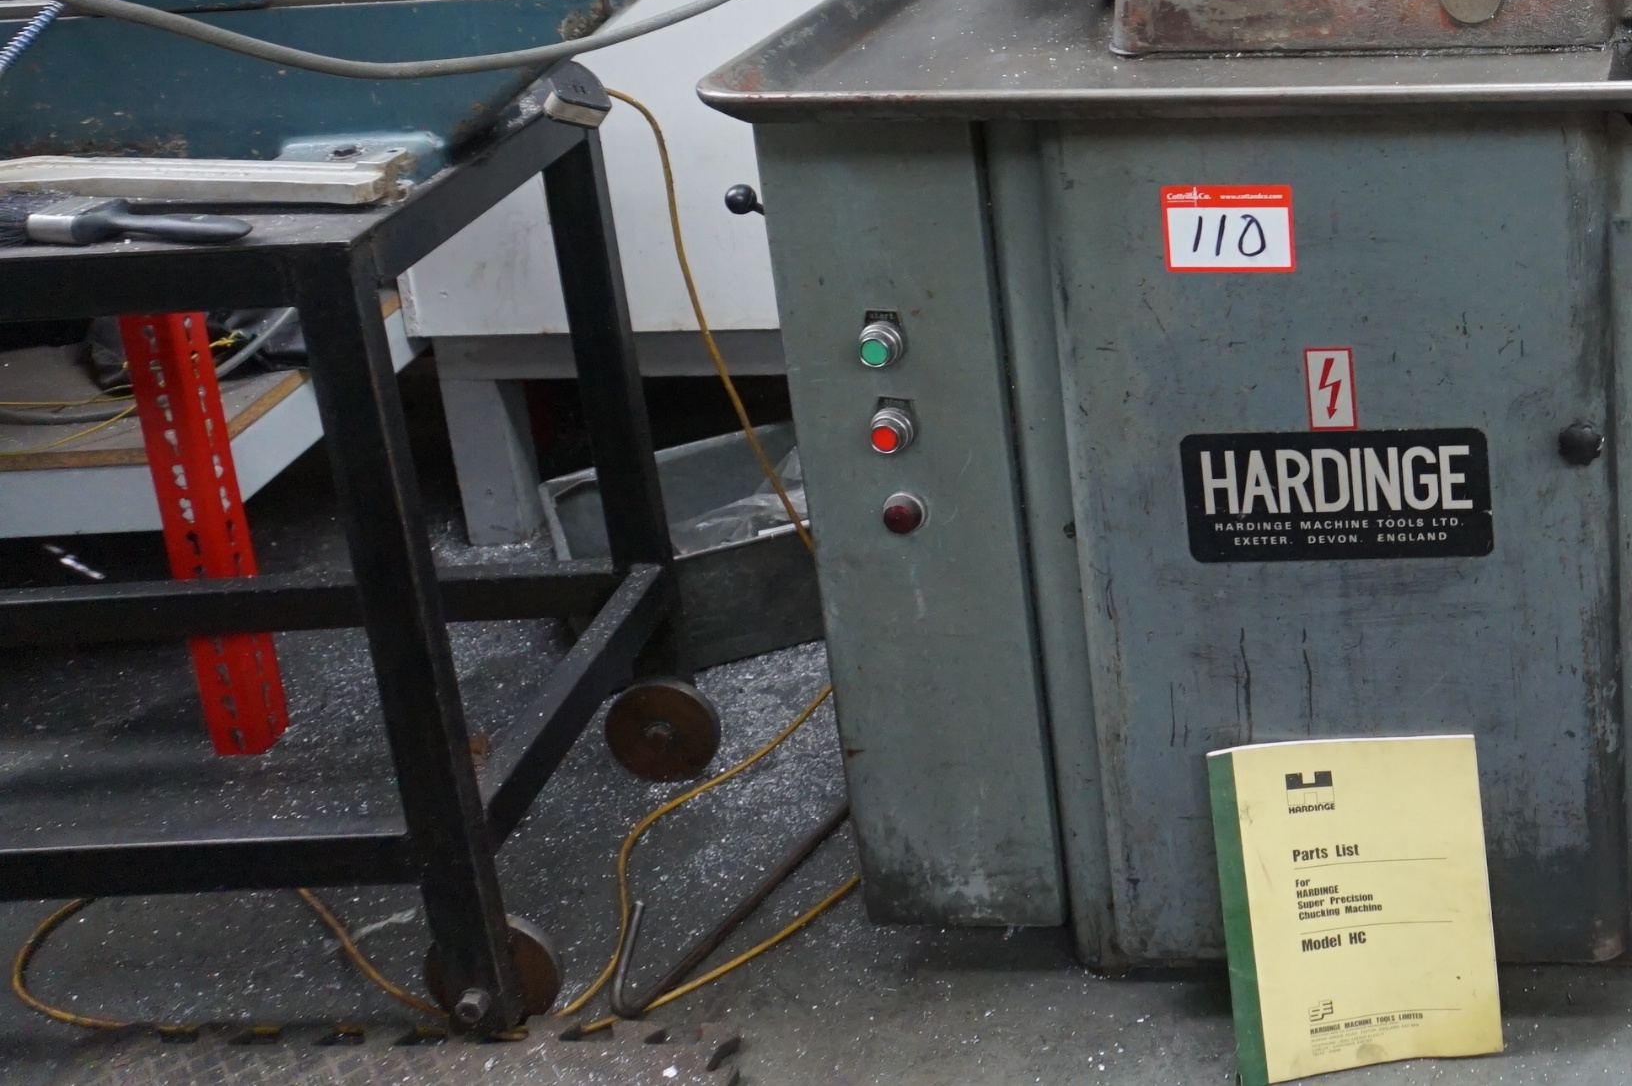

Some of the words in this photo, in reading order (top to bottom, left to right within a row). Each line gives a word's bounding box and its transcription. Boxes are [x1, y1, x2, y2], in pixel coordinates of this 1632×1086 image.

[1192, 214, 1266, 257] 110
[1200, 445, 1473, 515] HARDINGE
[1214, 521, 1293, 532] HARDINGE
[1300, 519, 1370, 530] MACHINE
[1376, 518, 1425, 528] TOOLS
[1432, 517, 1465, 527] LTD.
[1233, 536, 1293, 546] EXETER.
[1307, 534, 1364, 544] DEVON.
[1376, 532, 1448, 543] ENGLAND
[1288, 802, 1336, 815] HARDINGE
[1292, 847, 1329, 863] Parts
[1335, 843, 1360, 858] List
[1295, 878, 1310, 888] For
[1296, 884, 1339, 899] HARDINGE
[1297, 899, 1325, 910] Super
[1330, 893, 1374, 905] Precision
[1298, 907, 1341, 921] Chucking
[1344, 903, 1383, 914] Machine
[1301, 934, 1342, 953] Model
[1348, 930, 1367, 946] HC
[1309, 1023, 1341, 1035] HARDINGE
[1344, 1018, 1372, 1029] MACHINE
[1376, 1014, 1396, 1023] TOOLS
[1398, 1012, 1424, 1021] LIMITED
